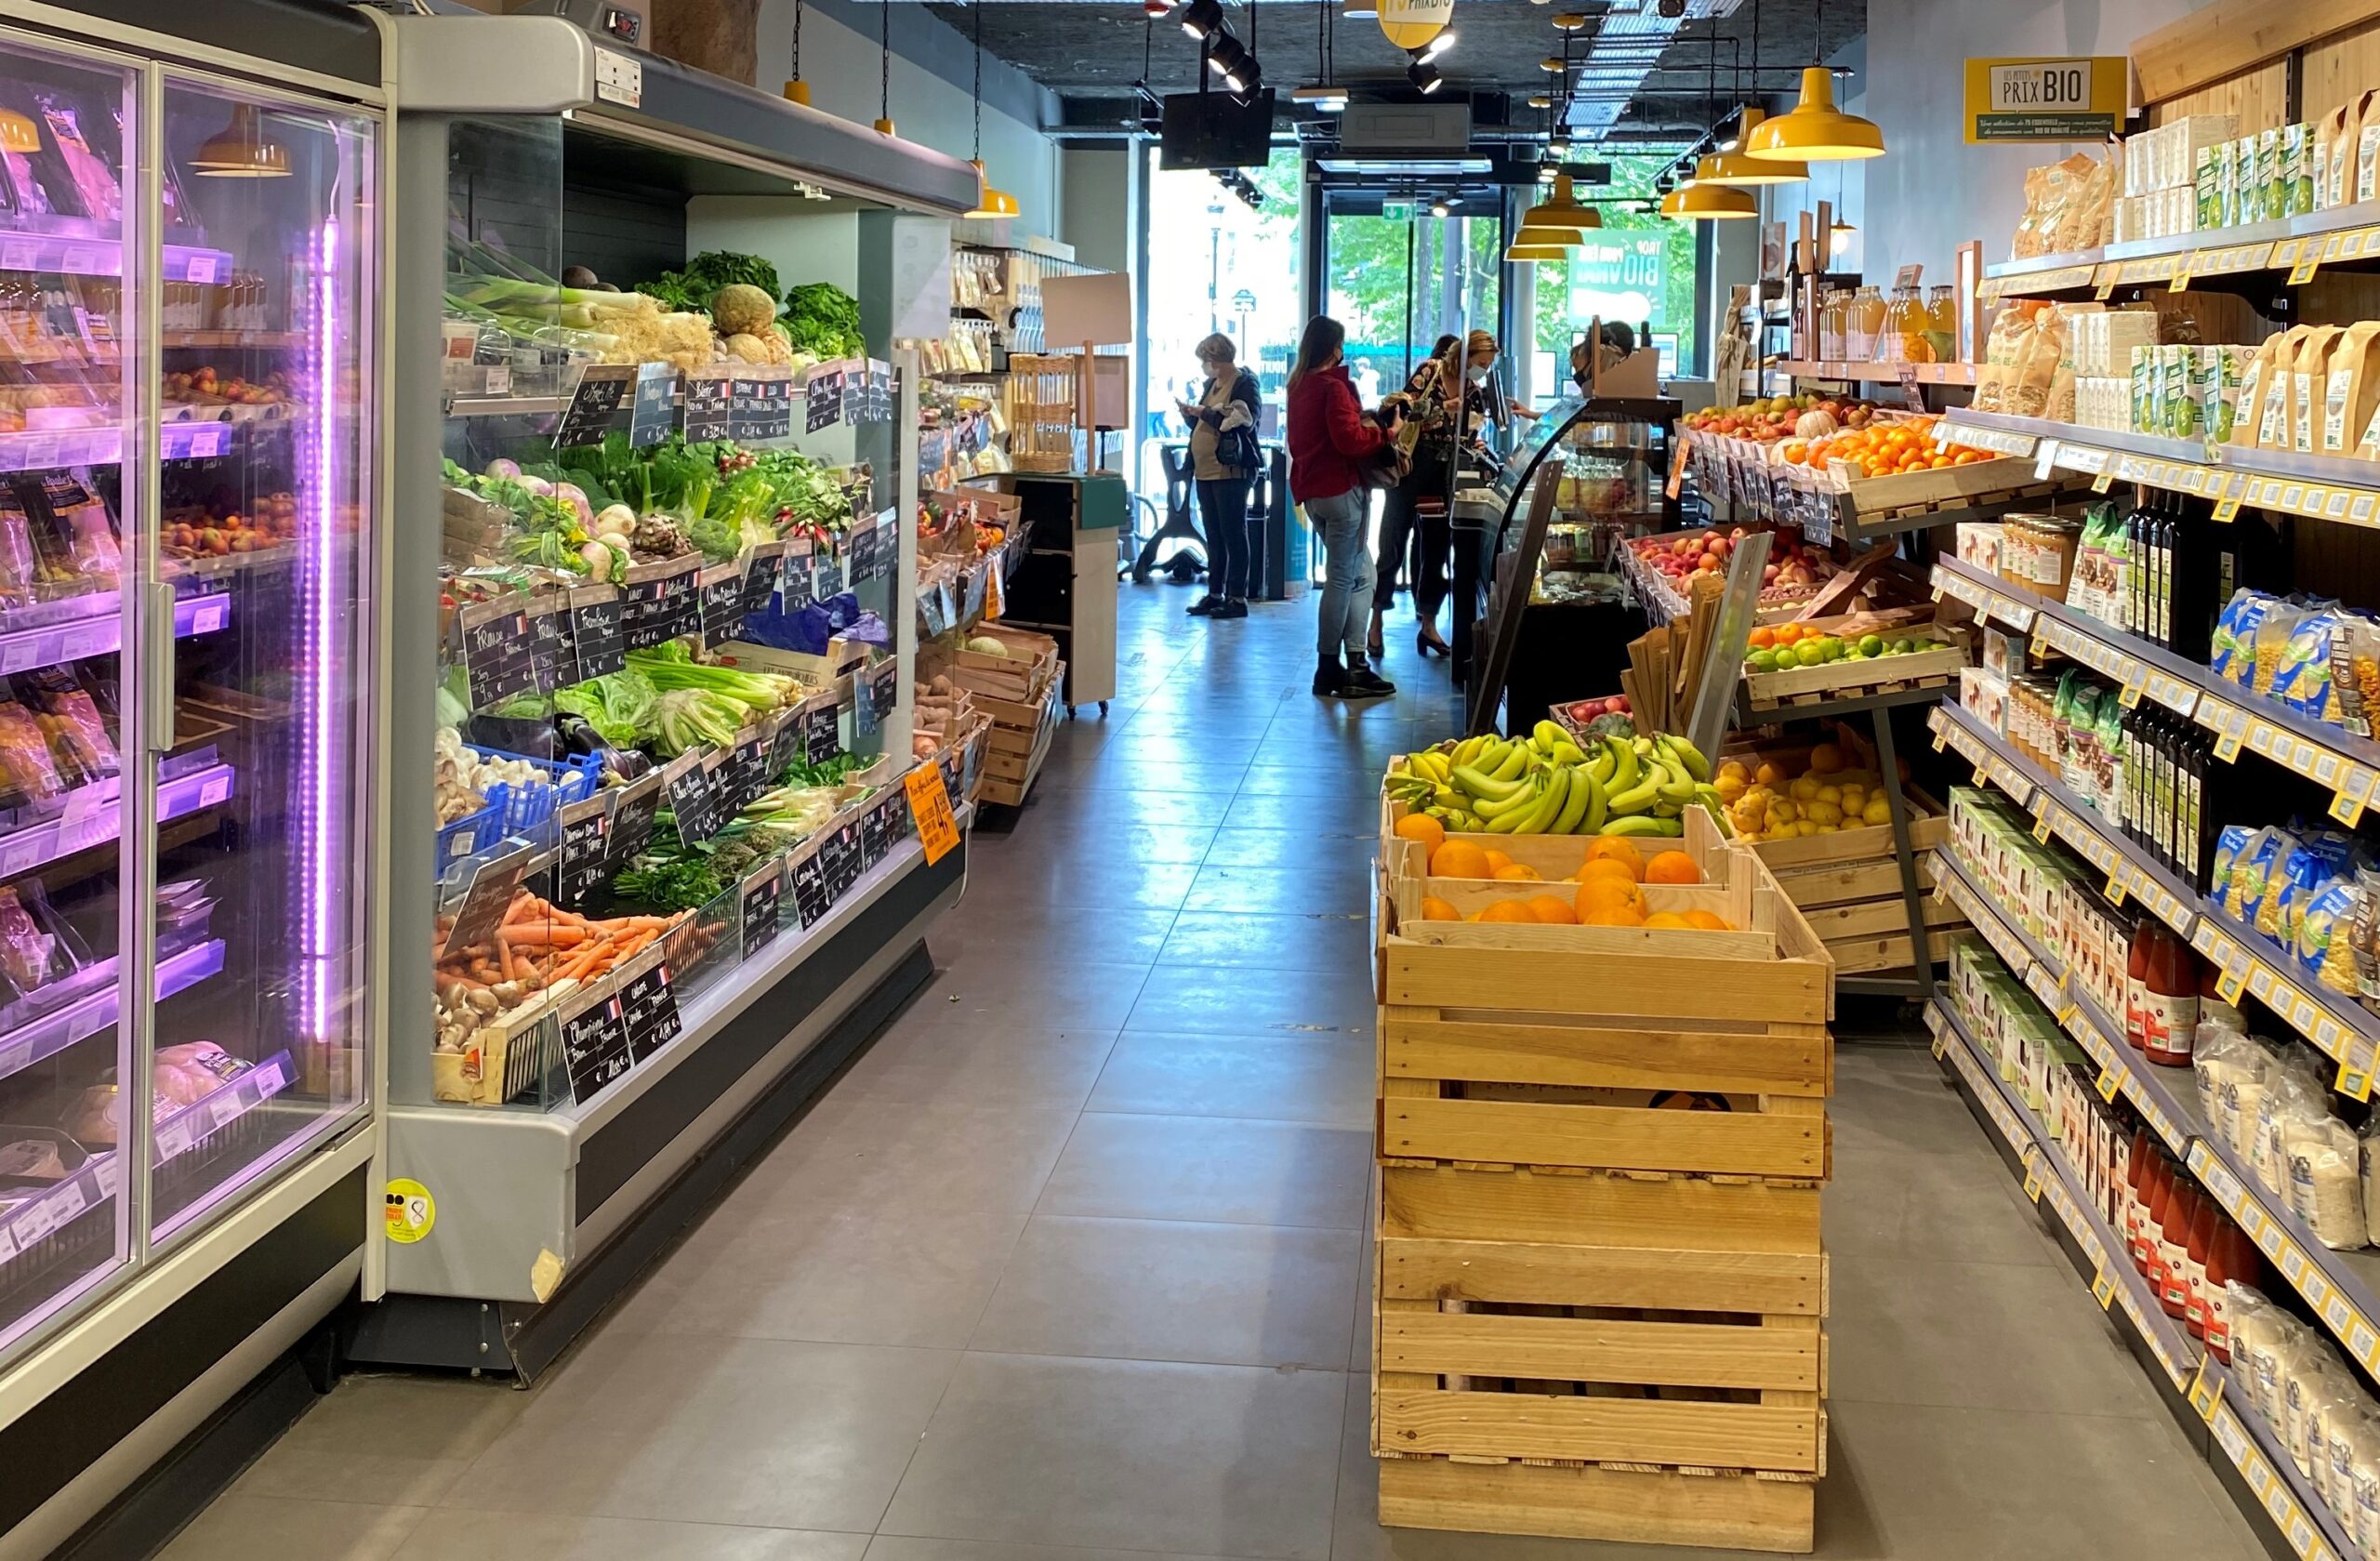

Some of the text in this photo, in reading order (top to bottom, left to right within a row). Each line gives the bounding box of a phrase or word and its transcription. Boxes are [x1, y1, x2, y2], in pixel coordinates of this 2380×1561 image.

[2003, 70, 2082, 103] PRIX BIO
[2013, 71, 2031, 81] PETITS
